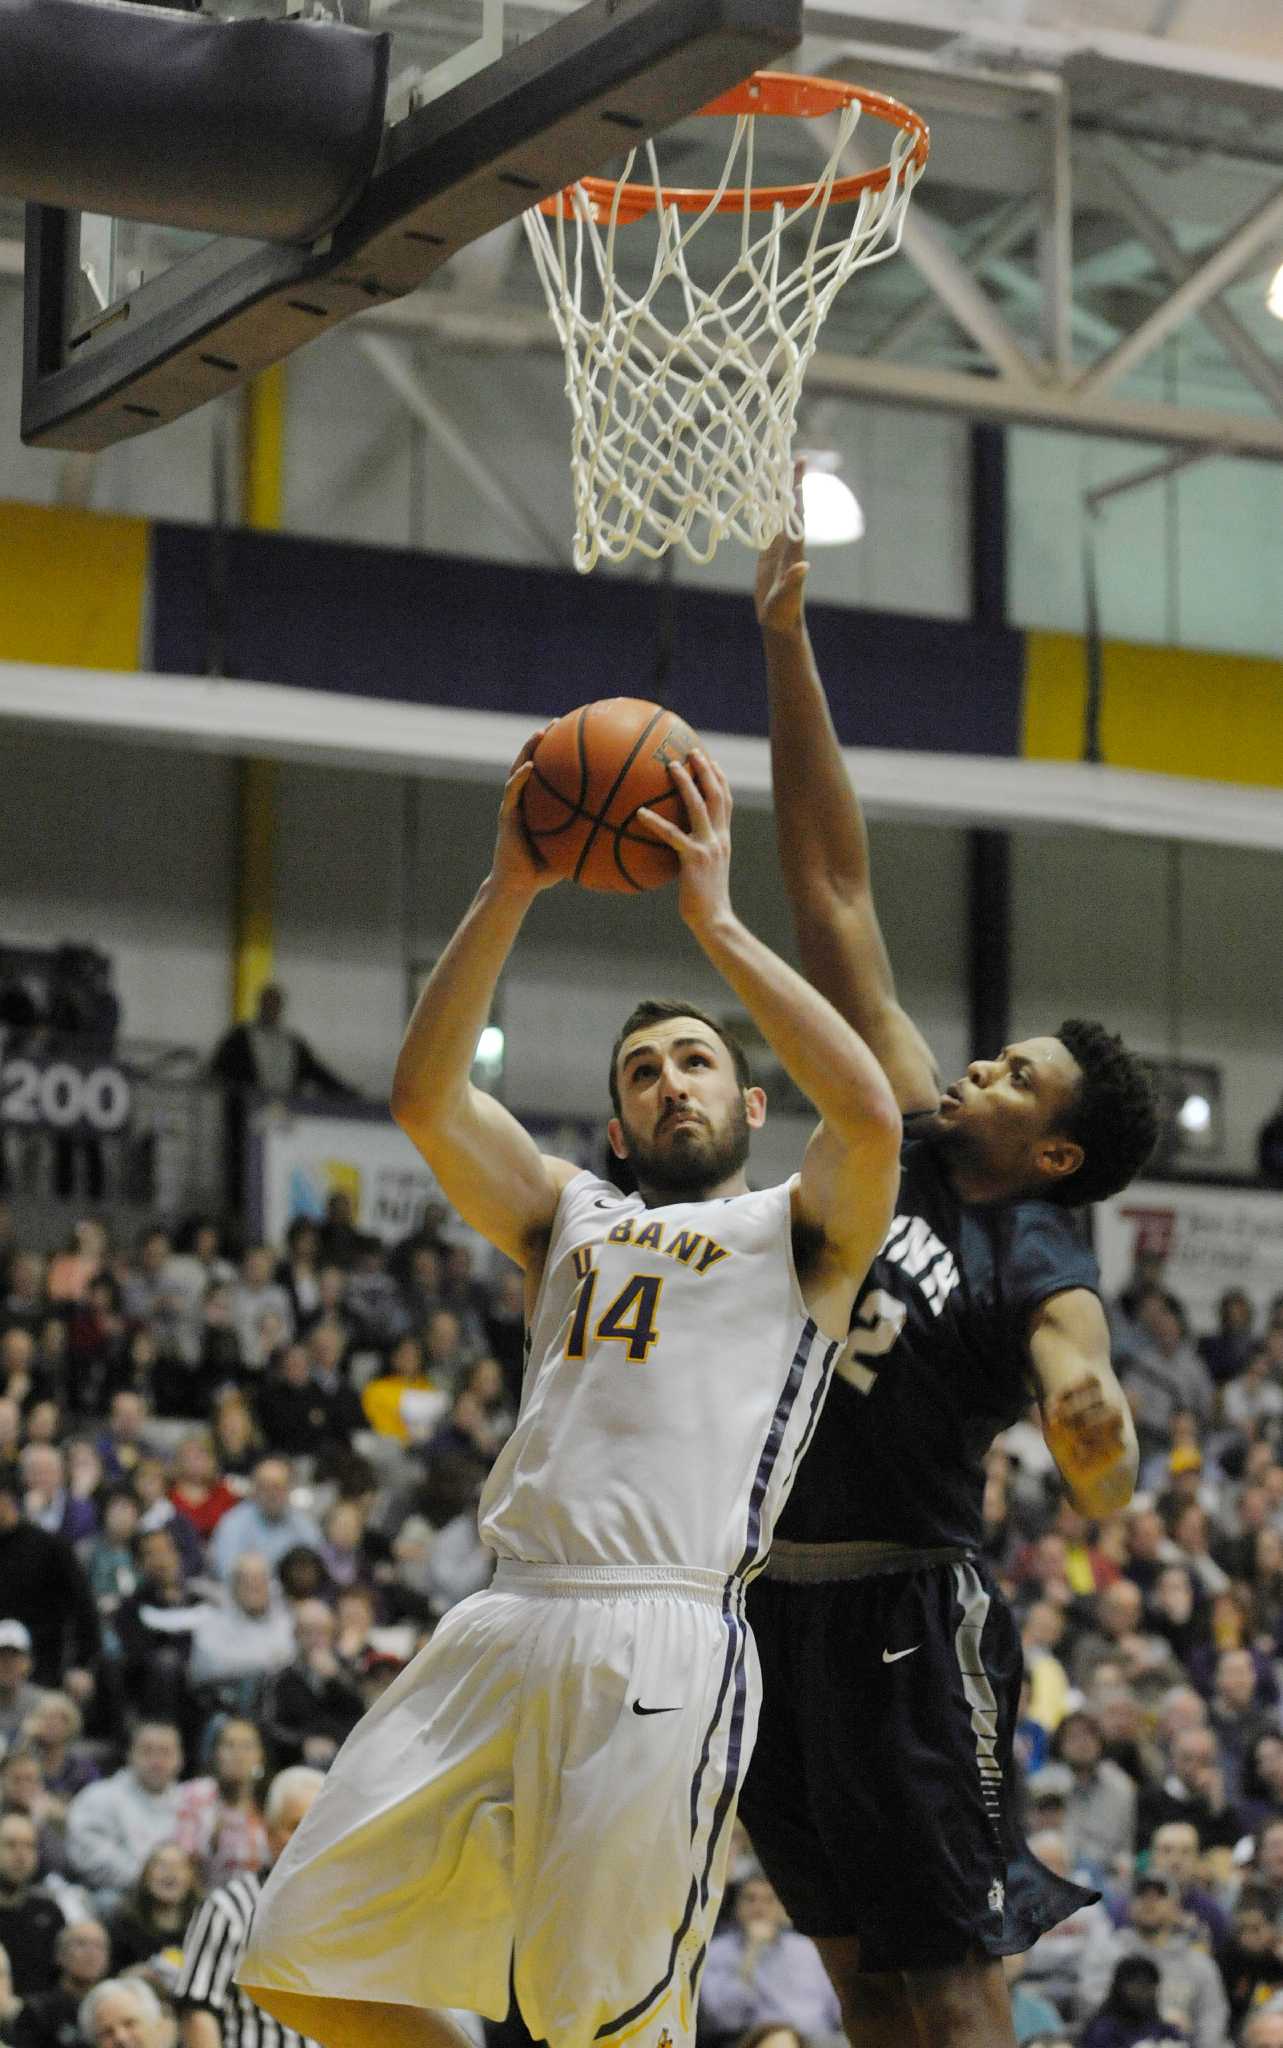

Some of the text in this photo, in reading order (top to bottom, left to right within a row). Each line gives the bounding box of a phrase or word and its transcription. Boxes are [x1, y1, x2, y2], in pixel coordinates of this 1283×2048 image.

[1, 1059, 130, 1129] 200
[563, 1268, 665, 1364] 14
[836, 1288, 907, 1396] 2
